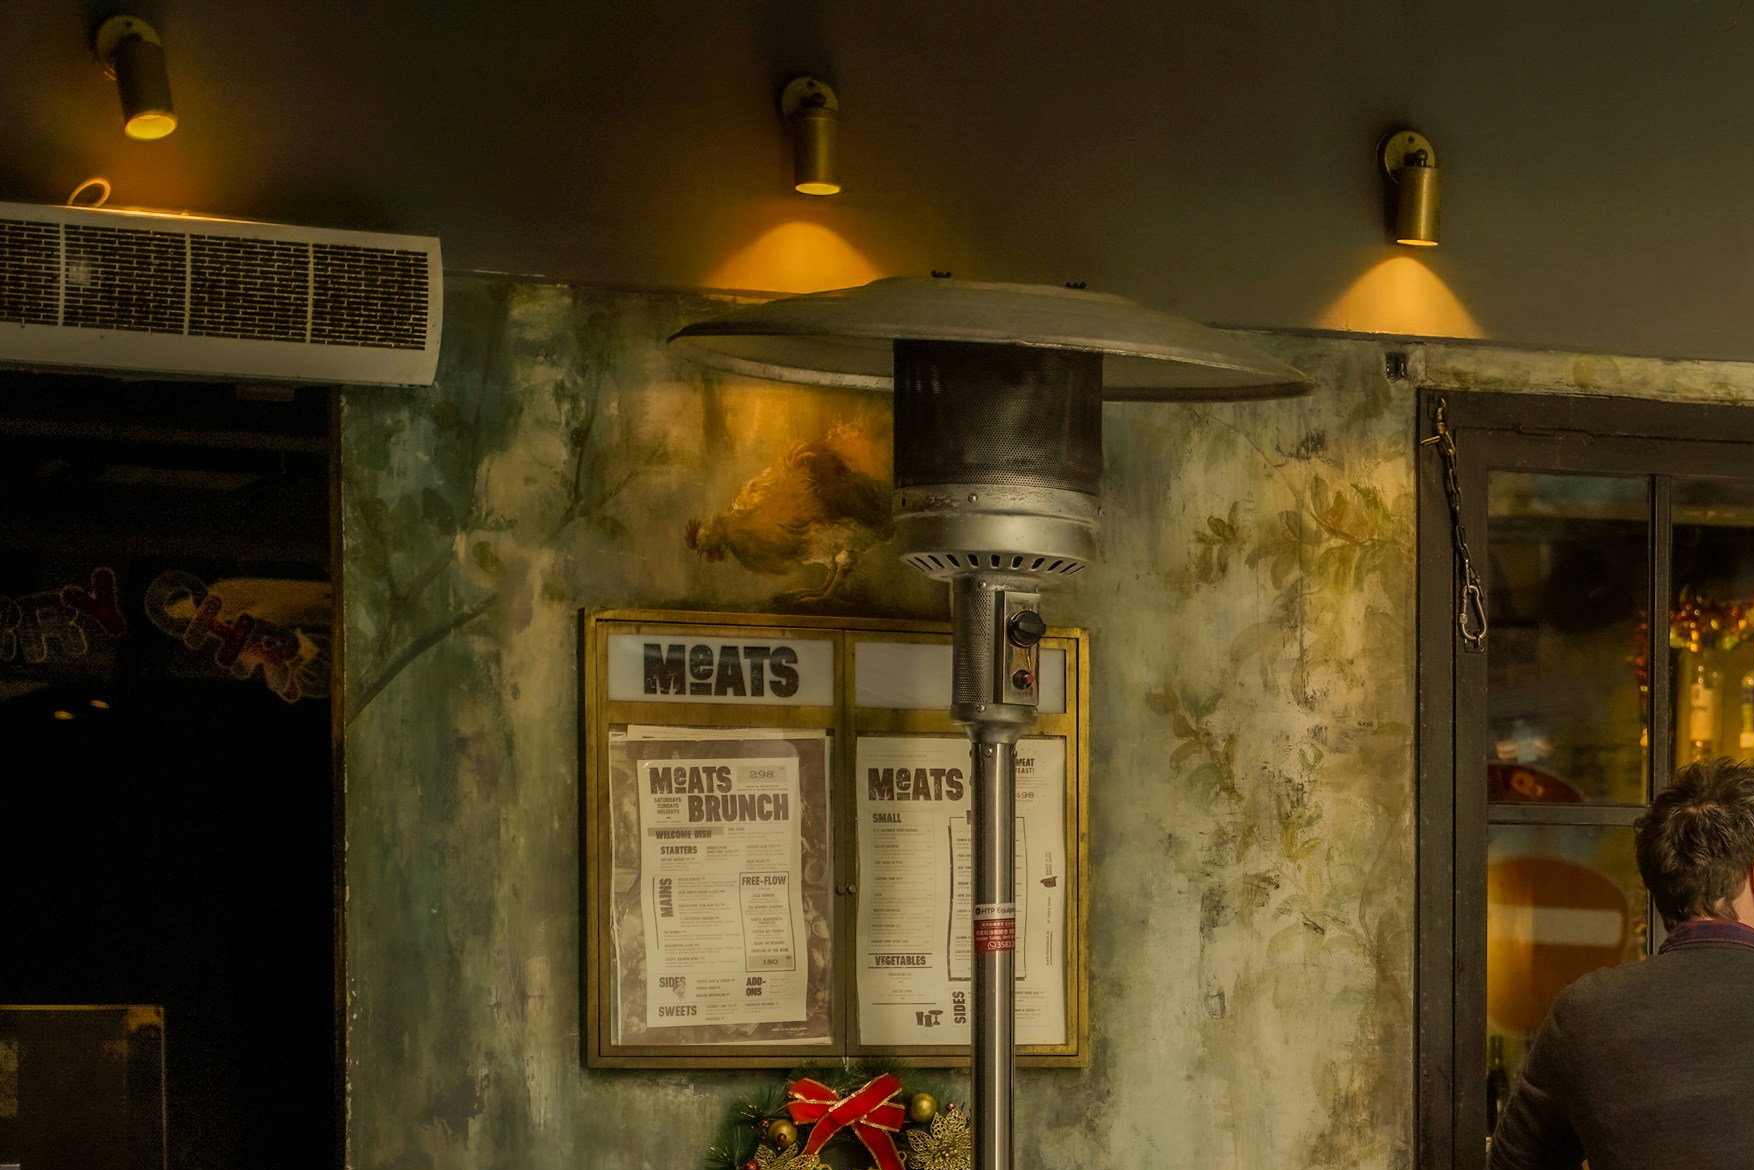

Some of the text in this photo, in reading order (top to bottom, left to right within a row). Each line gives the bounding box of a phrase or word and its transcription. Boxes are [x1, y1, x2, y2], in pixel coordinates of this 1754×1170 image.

[750, 770, 774, 779] 298
[687, 794, 790, 823] BRUNCH
[872, 813, 902, 823] SMALL
[655, 830, 712, 840] WELCOME DISH
[660, 845, 698, 855] STARTERS
[741, 876, 787, 886] FREE-FLOW
[658, 877, 674, 918] MAINS
[875, 955, 926, 966] VEGETABLES
[659, 976, 686, 988] SIDES
[746, 977, 766, 986] ADD-
[746, 988, 762, 997] ONS
[658, 1005, 698, 1017] SWEETS
[952, 990, 967, 1024] SIDES
